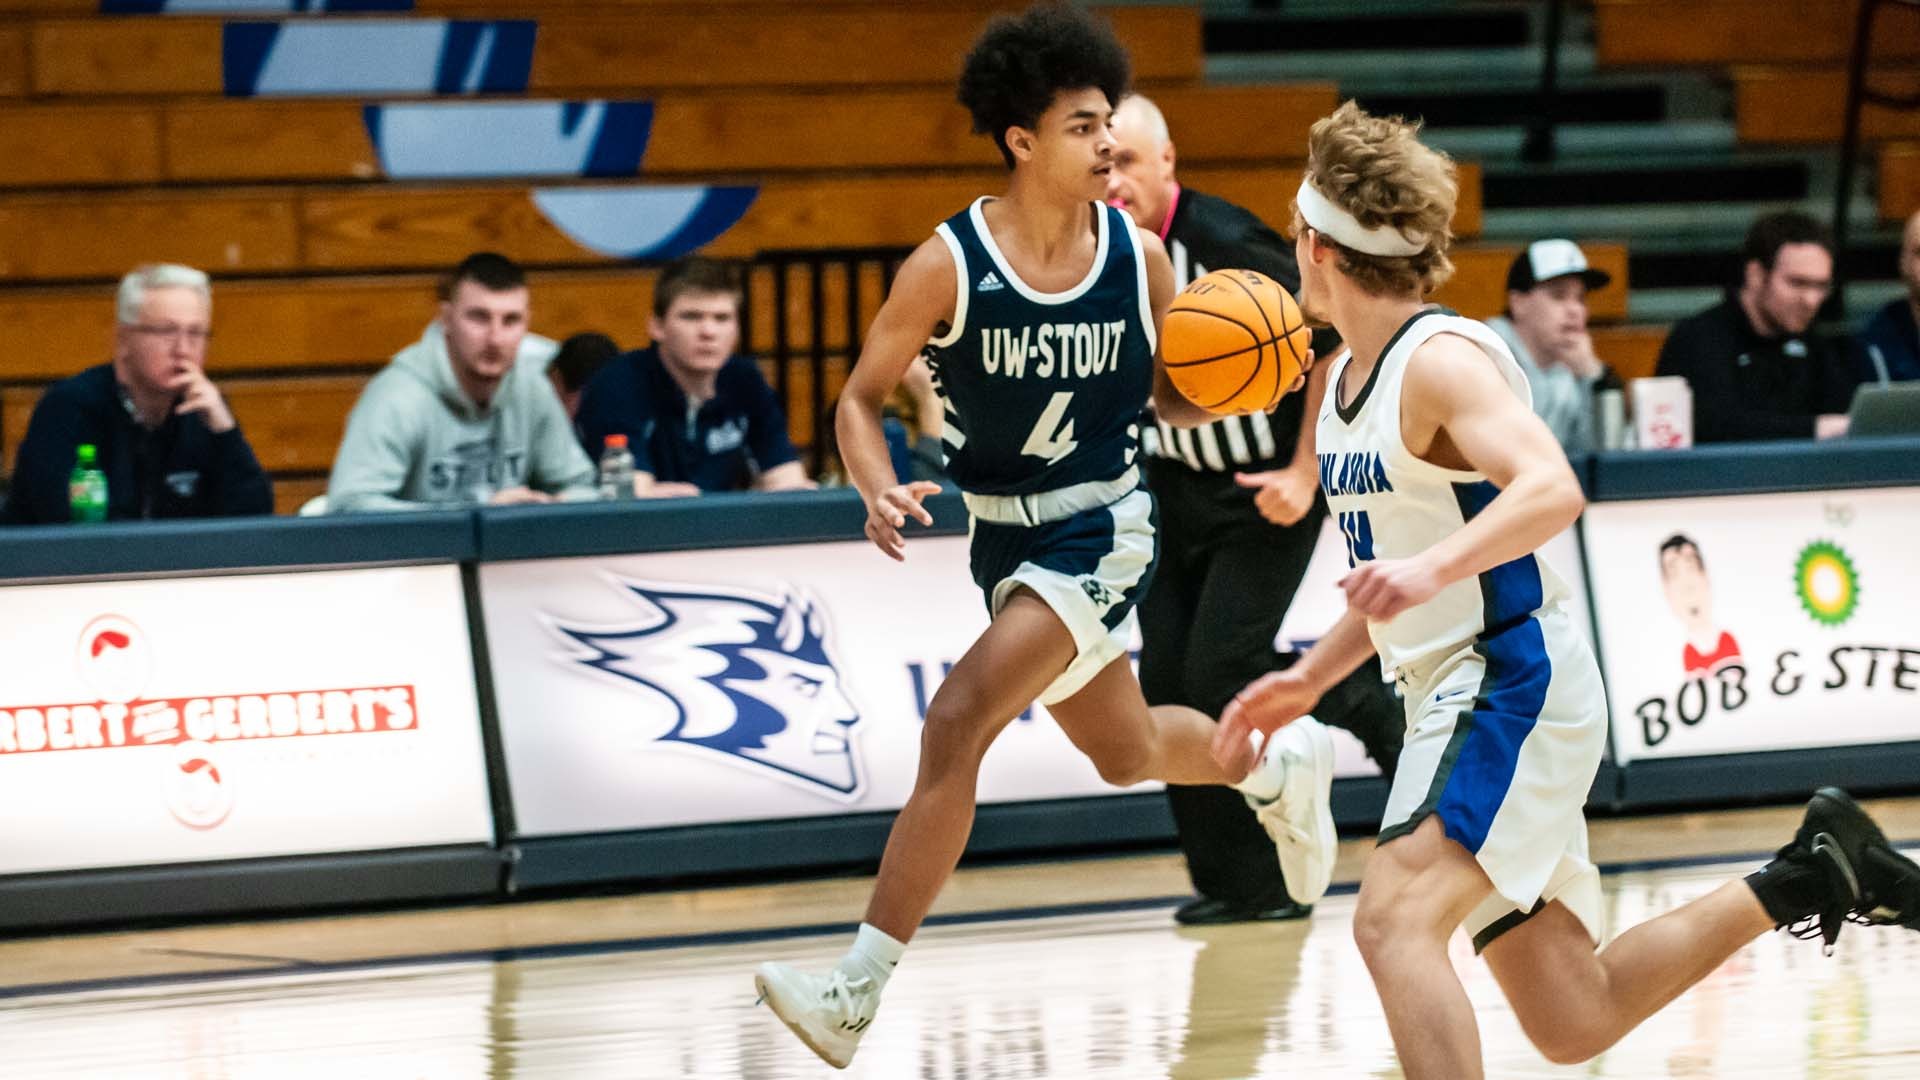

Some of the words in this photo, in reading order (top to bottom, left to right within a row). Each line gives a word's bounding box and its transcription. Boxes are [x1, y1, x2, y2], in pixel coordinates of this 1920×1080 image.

[981, 319, 1126, 380] UW-STOUT
[1020, 391, 1079, 467] 4
[431, 452, 523, 492] STUT
[1316, 451, 1394, 496] NLANDIA
[183, 687, 414, 741] GERBERT'S
[1635, 664, 1749, 747] BOB
[1771, 650, 1803, 696] &
[1824, 646, 1920, 692] STE
